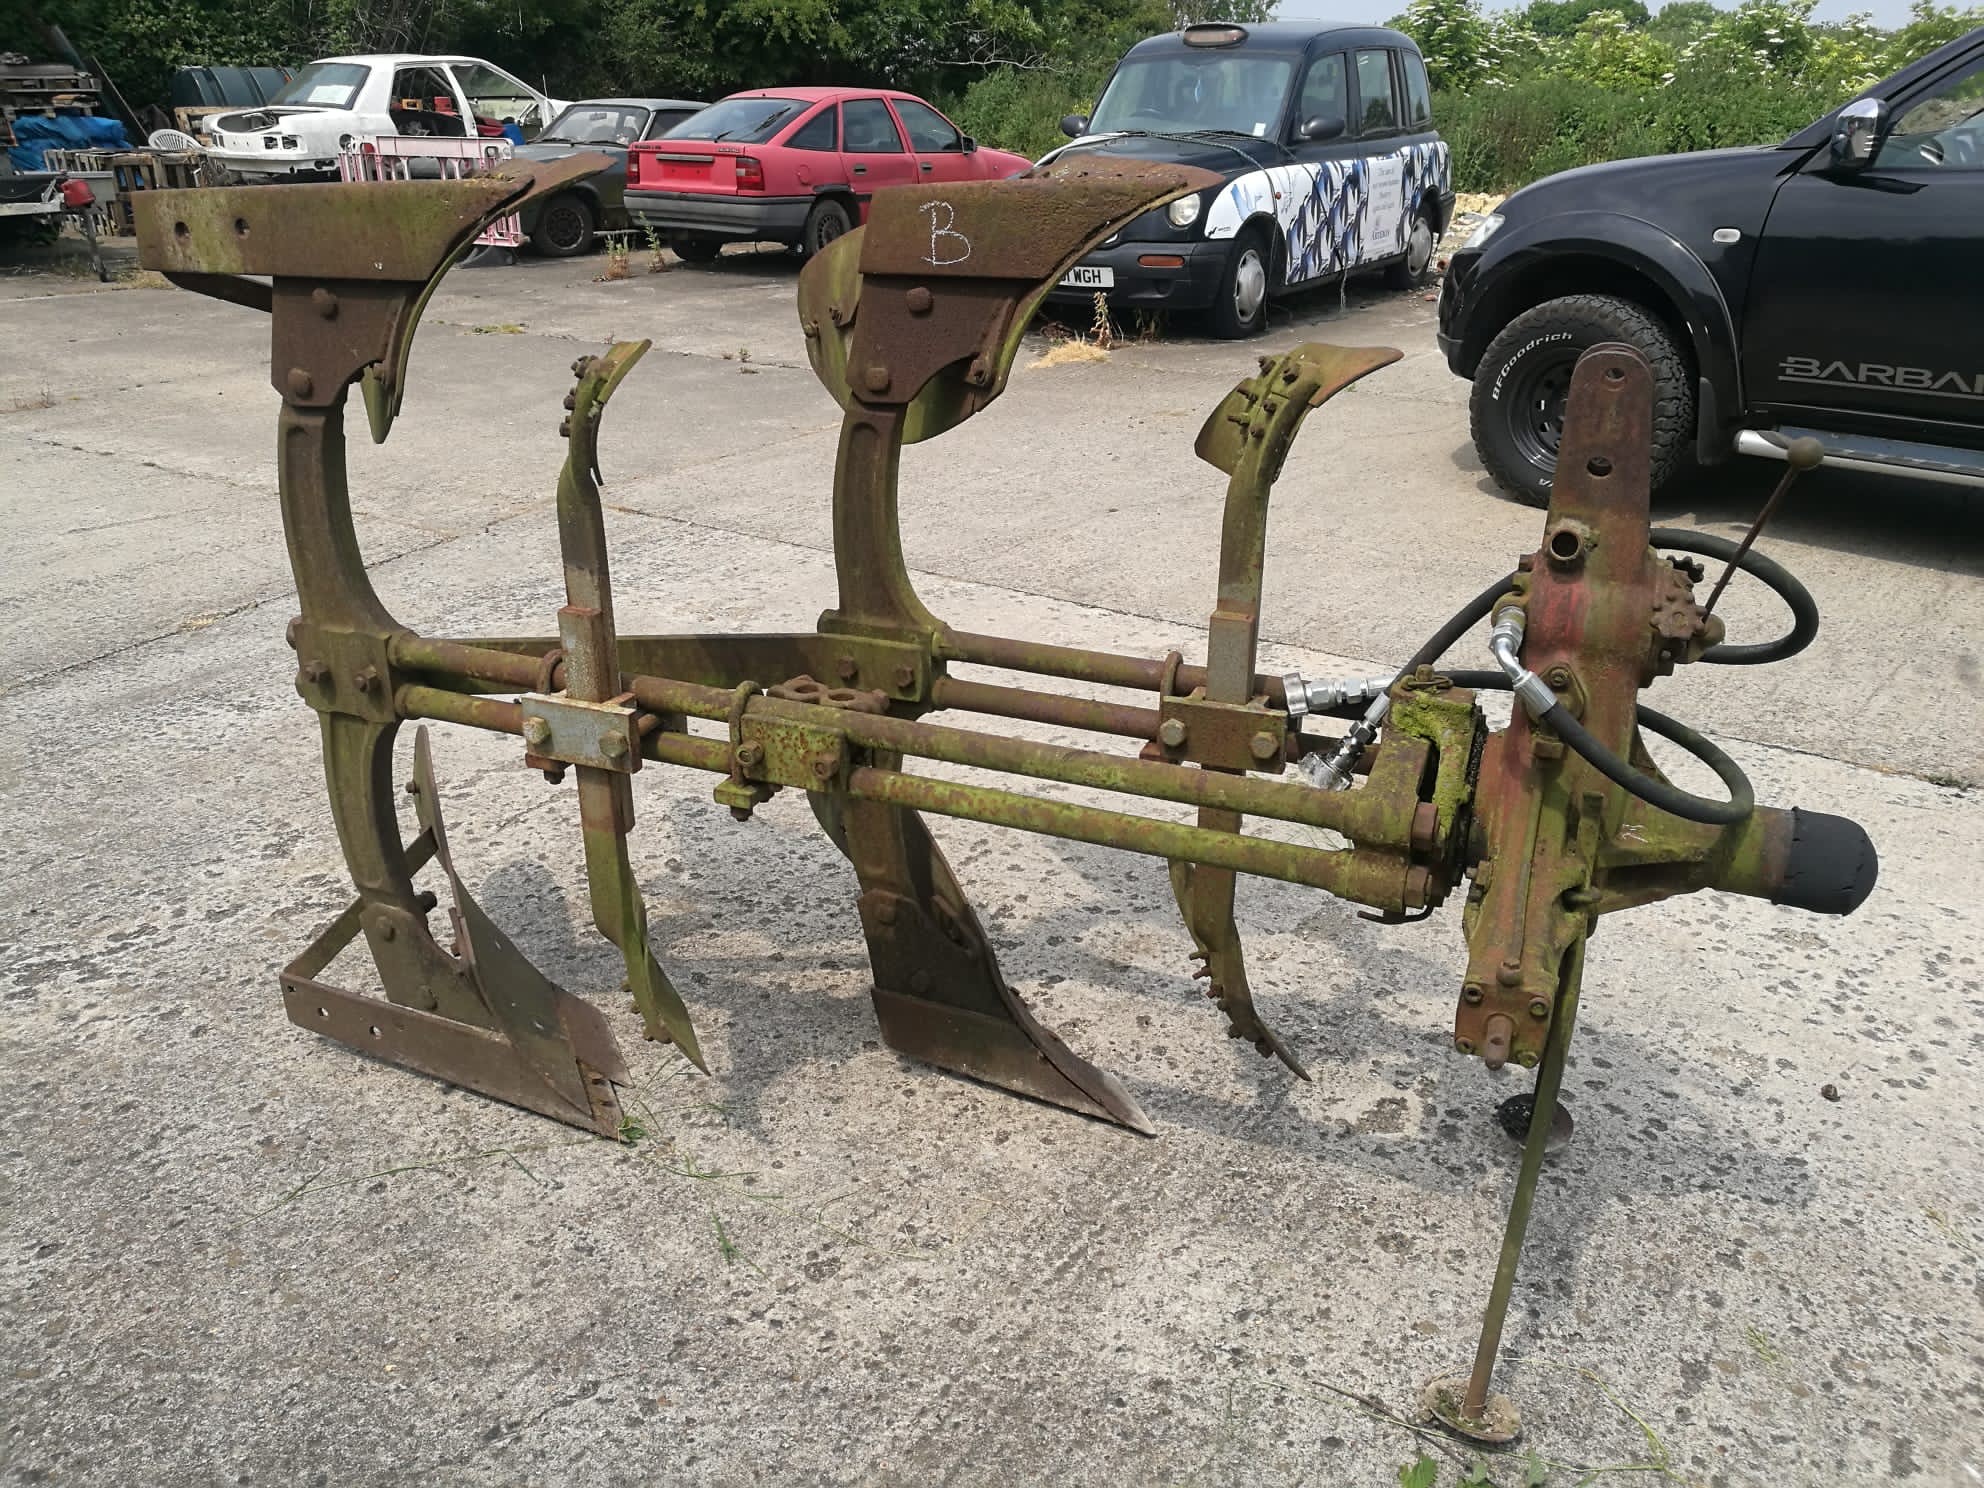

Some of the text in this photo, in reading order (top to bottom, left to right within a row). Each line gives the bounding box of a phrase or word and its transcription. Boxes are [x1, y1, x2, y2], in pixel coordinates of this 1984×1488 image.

[920, 200, 971, 266] B
[1073, 268, 1101, 284] WGH
[1492, 332, 1573, 401] BFGoodrich
